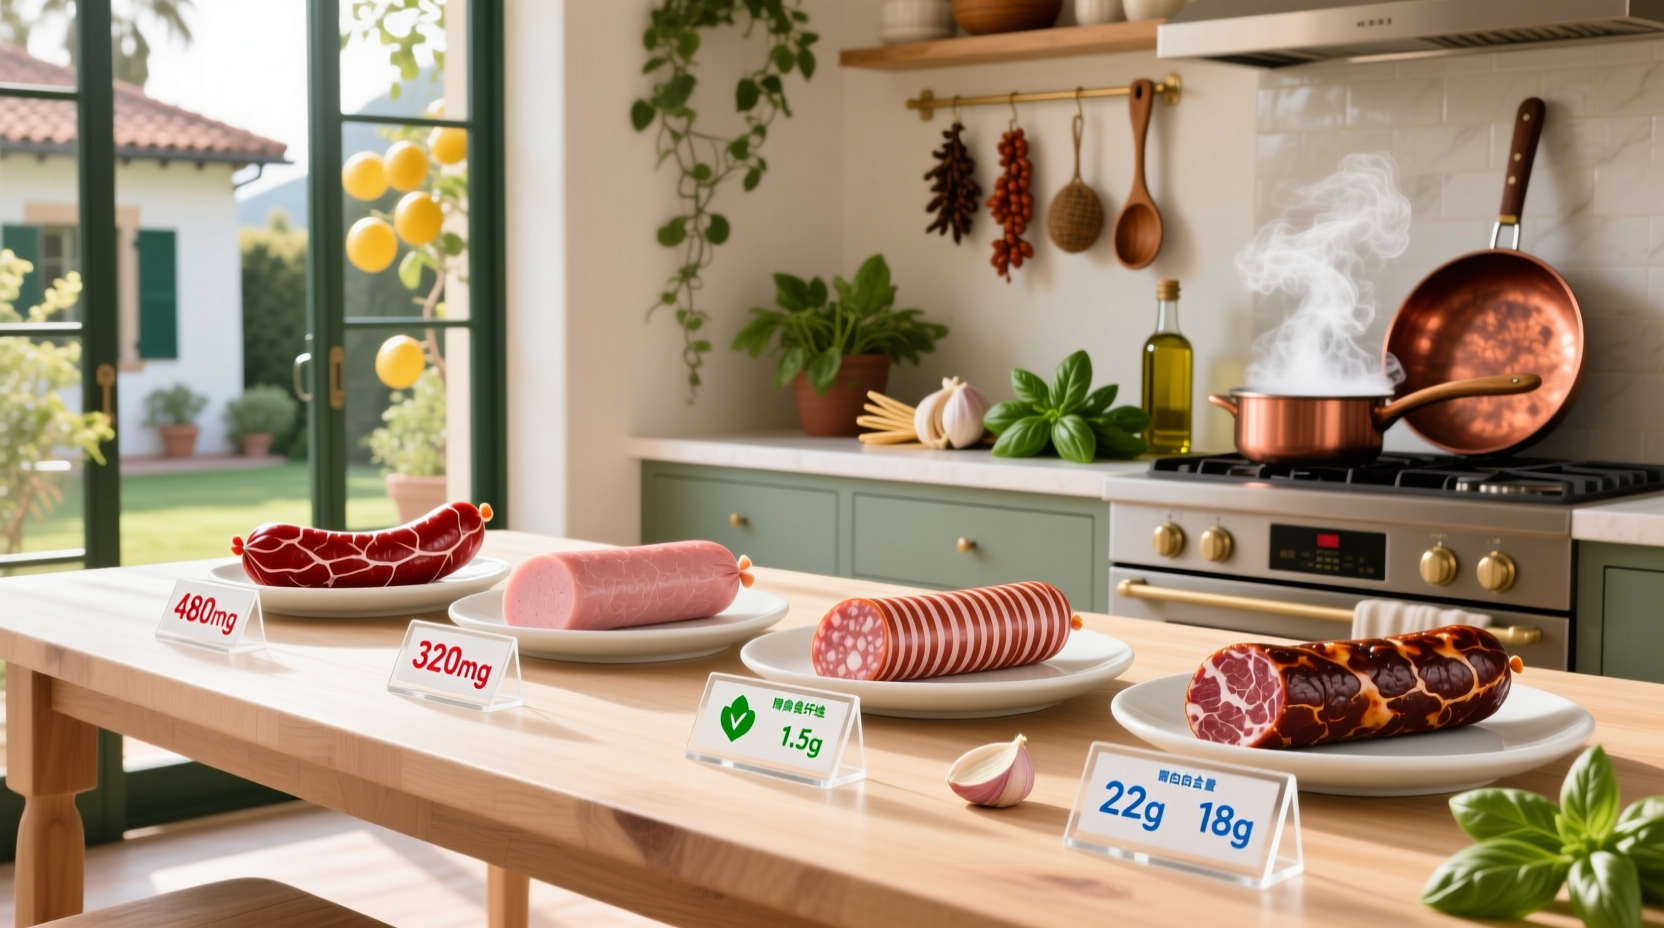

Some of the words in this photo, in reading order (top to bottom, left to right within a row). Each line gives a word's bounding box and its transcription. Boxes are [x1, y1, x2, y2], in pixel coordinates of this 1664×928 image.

[174, 593, 238, 636] 480mg
[412, 640, 493, 690] 320mg
[782, 725, 823, 759] 1.5g
[1099, 780, 1166, 832] 22g
[1199, 800, 1255, 849] 18g
